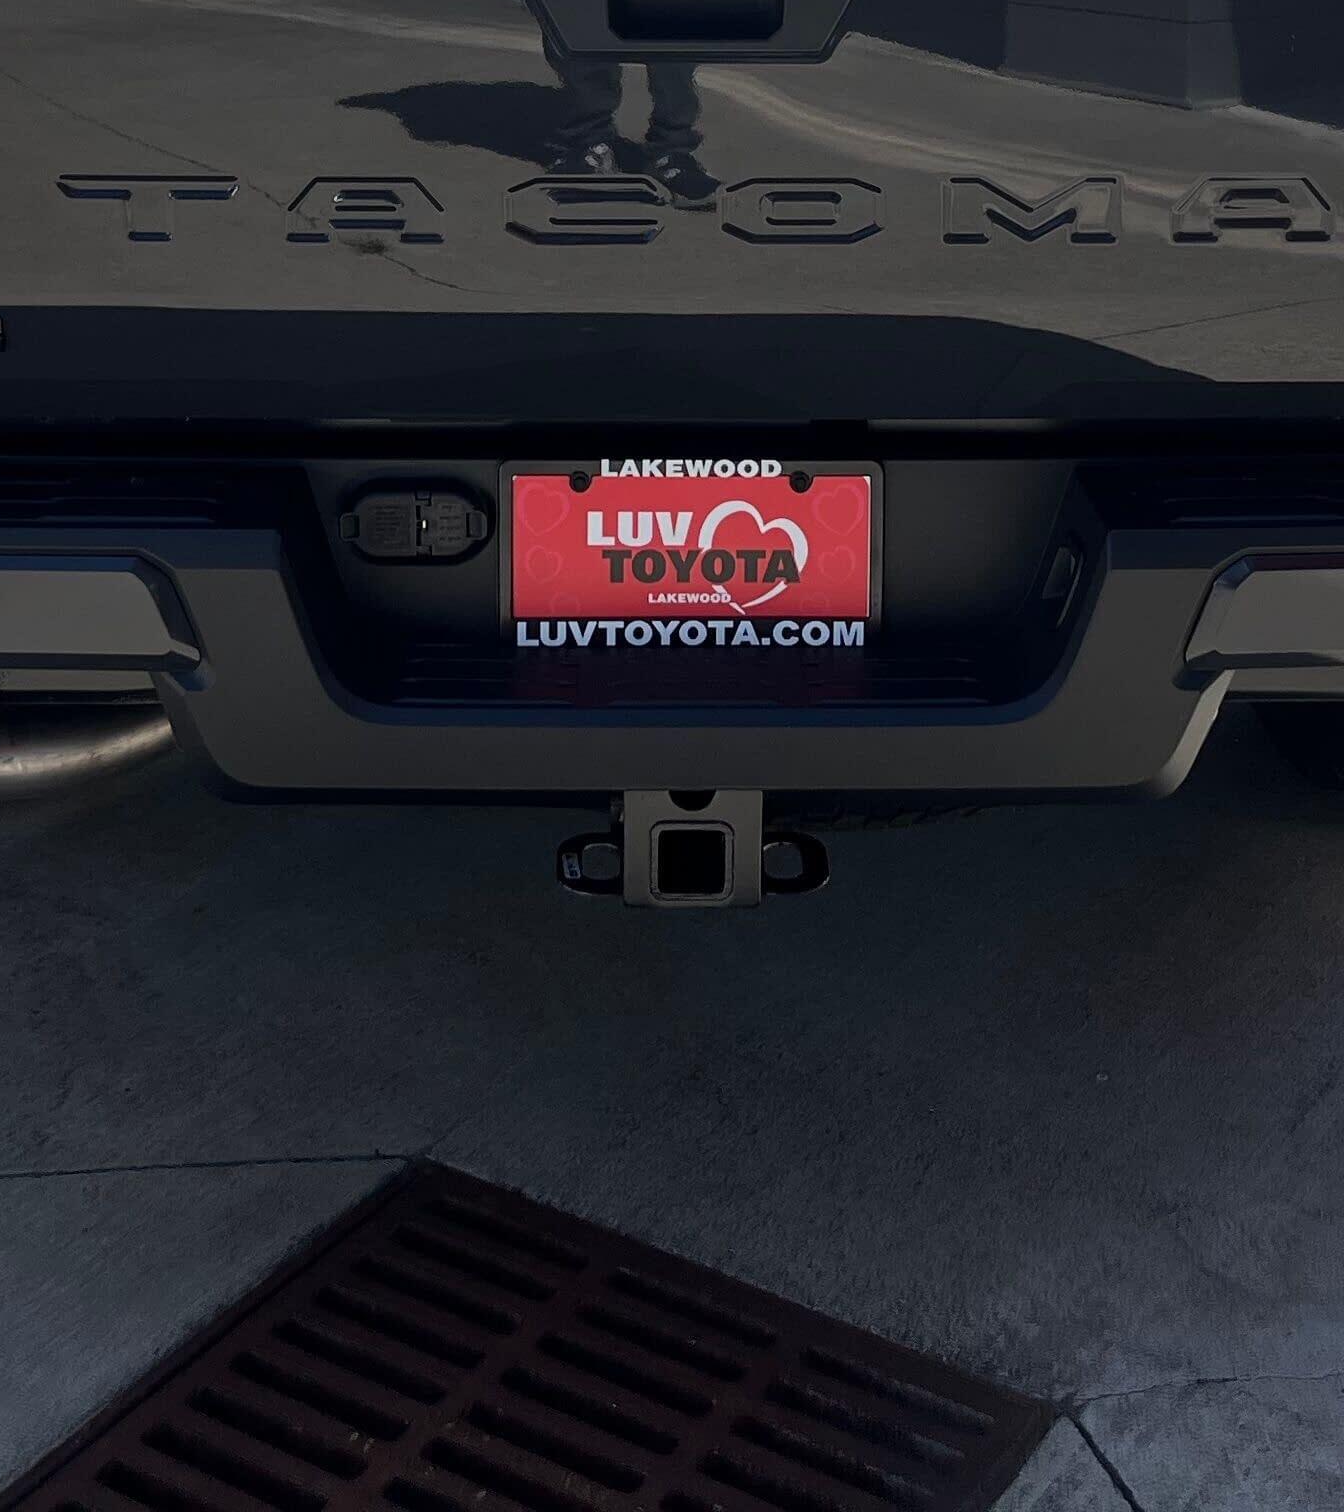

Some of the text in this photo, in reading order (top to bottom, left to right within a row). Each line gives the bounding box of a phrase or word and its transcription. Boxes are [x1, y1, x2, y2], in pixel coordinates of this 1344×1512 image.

[56, 173, 1337, 245] TACOMA
[600, 458, 783, 478] LAKEWOOD
[586, 511, 694, 547] LUV
[601, 549, 801, 584] TOYOTA
[647, 592, 732, 604] LAKEWOOD
[516, 620, 865, 647] LUVTOYOTA.COM
